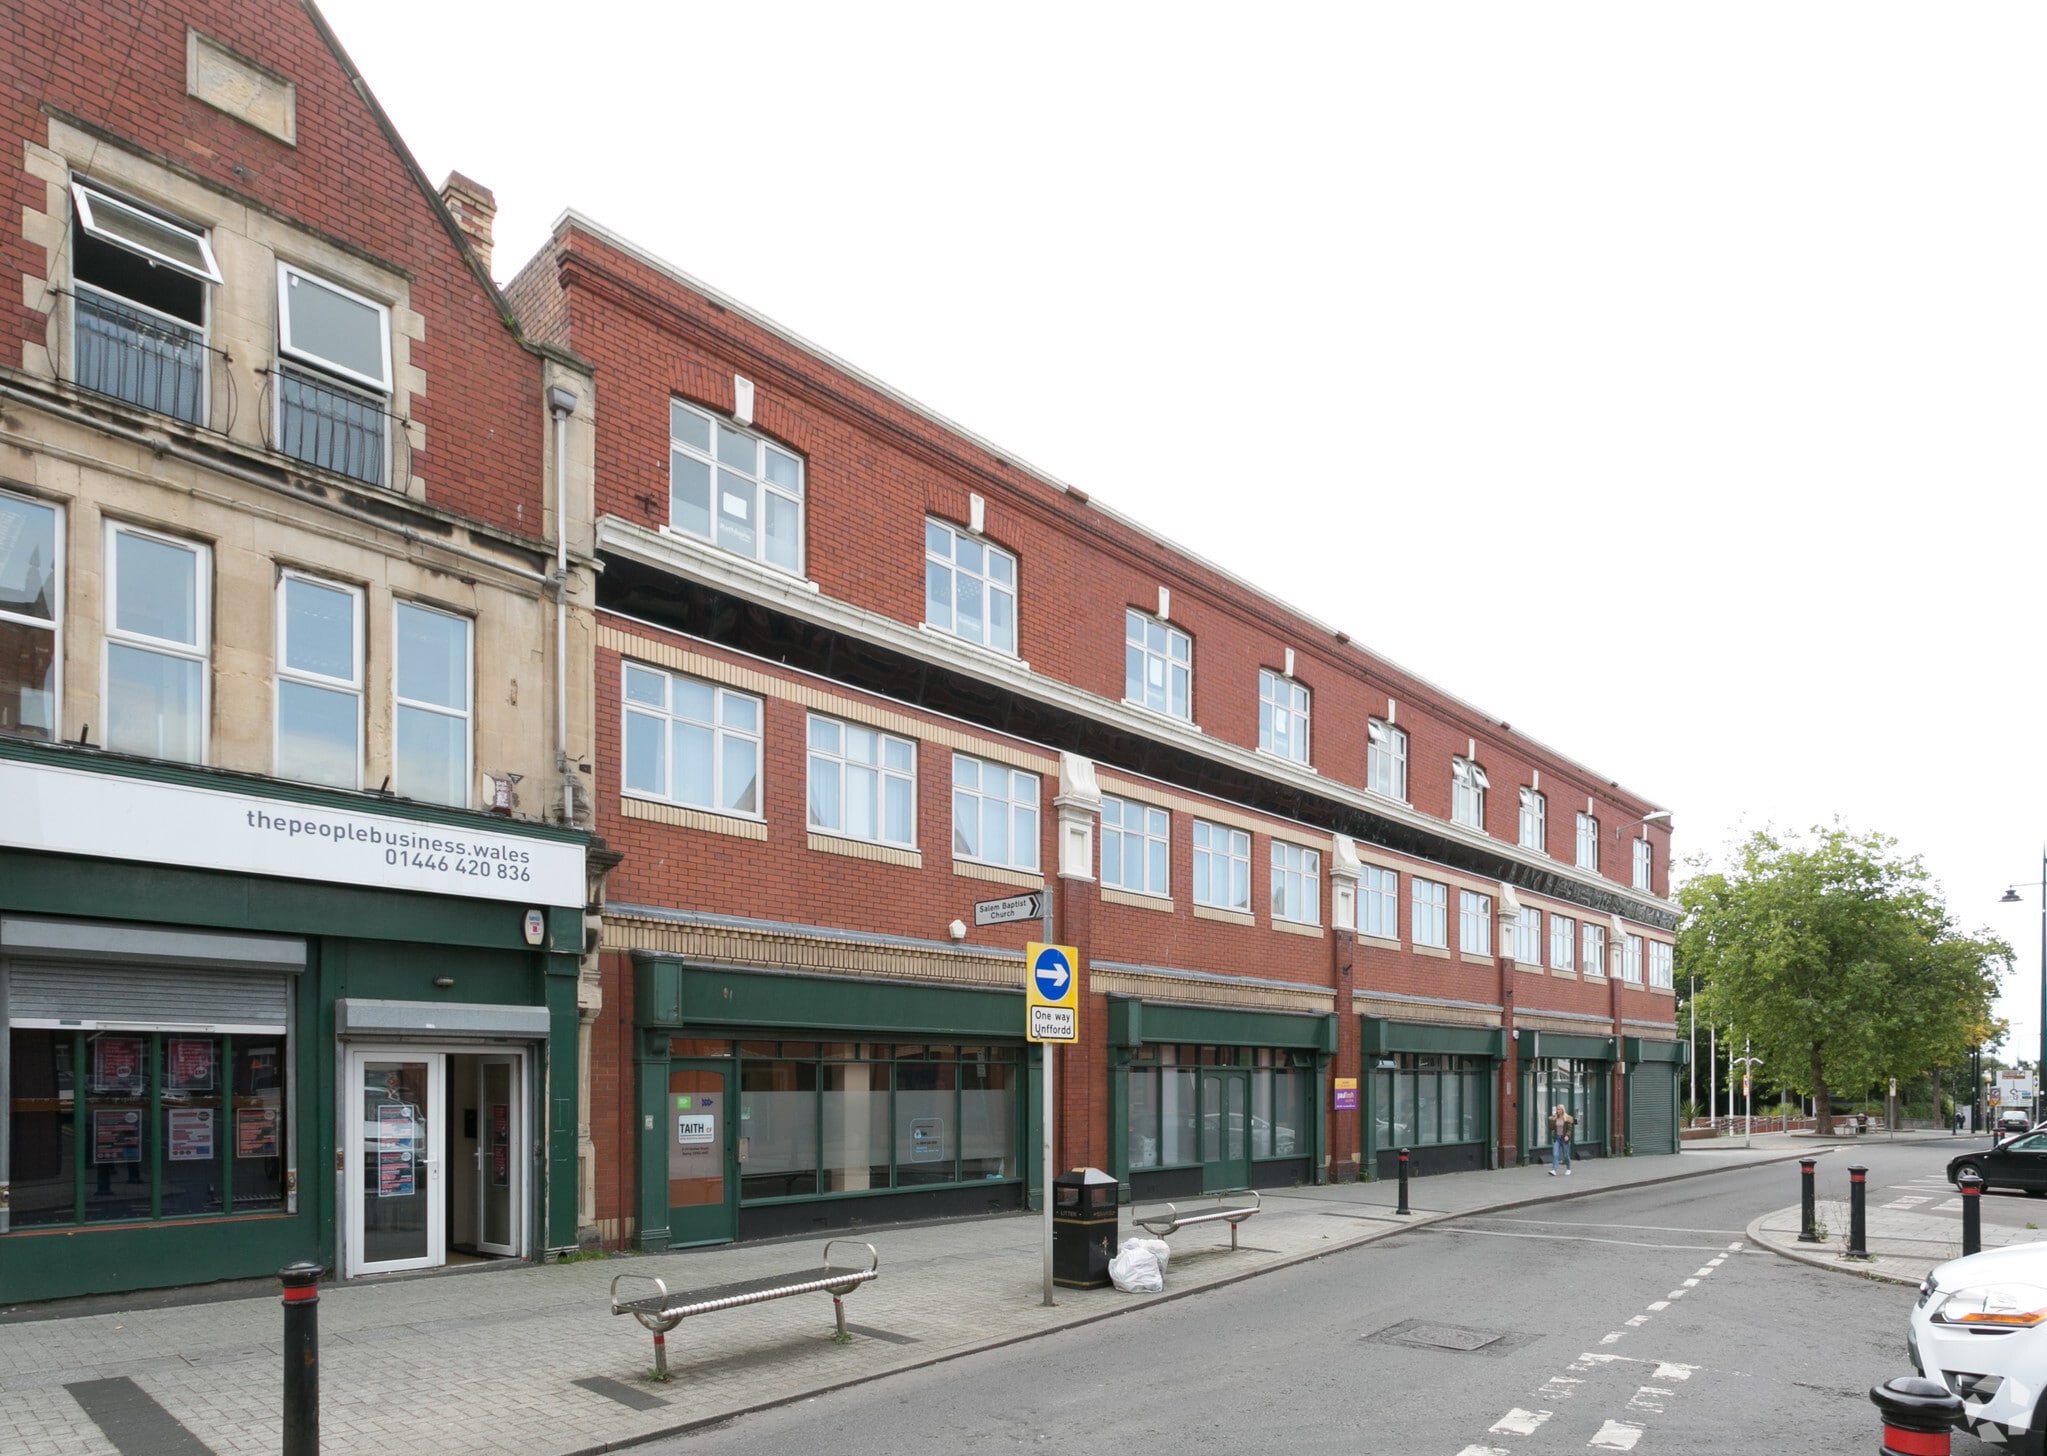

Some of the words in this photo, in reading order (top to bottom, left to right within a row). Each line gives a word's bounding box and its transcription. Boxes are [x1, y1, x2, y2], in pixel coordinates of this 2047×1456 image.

[246, 810, 530, 863] thepeoplebusiness.wales
[385, 849, 449, 872] 01446
[455, 858, 491, 877] 420
[497, 865, 530, 882] 836
[979, 904, 1000, 913] Salem
[1002, 900, 1027, 910] Baptist
[990, 910, 1015, 919] Church
[1035, 1010, 1052, 1020] One
[1055, 1013, 1071, 1023] way
[1035, 1023, 1071, 1035] Unffordd
[680, 1123, 704, 1134] TAITH
